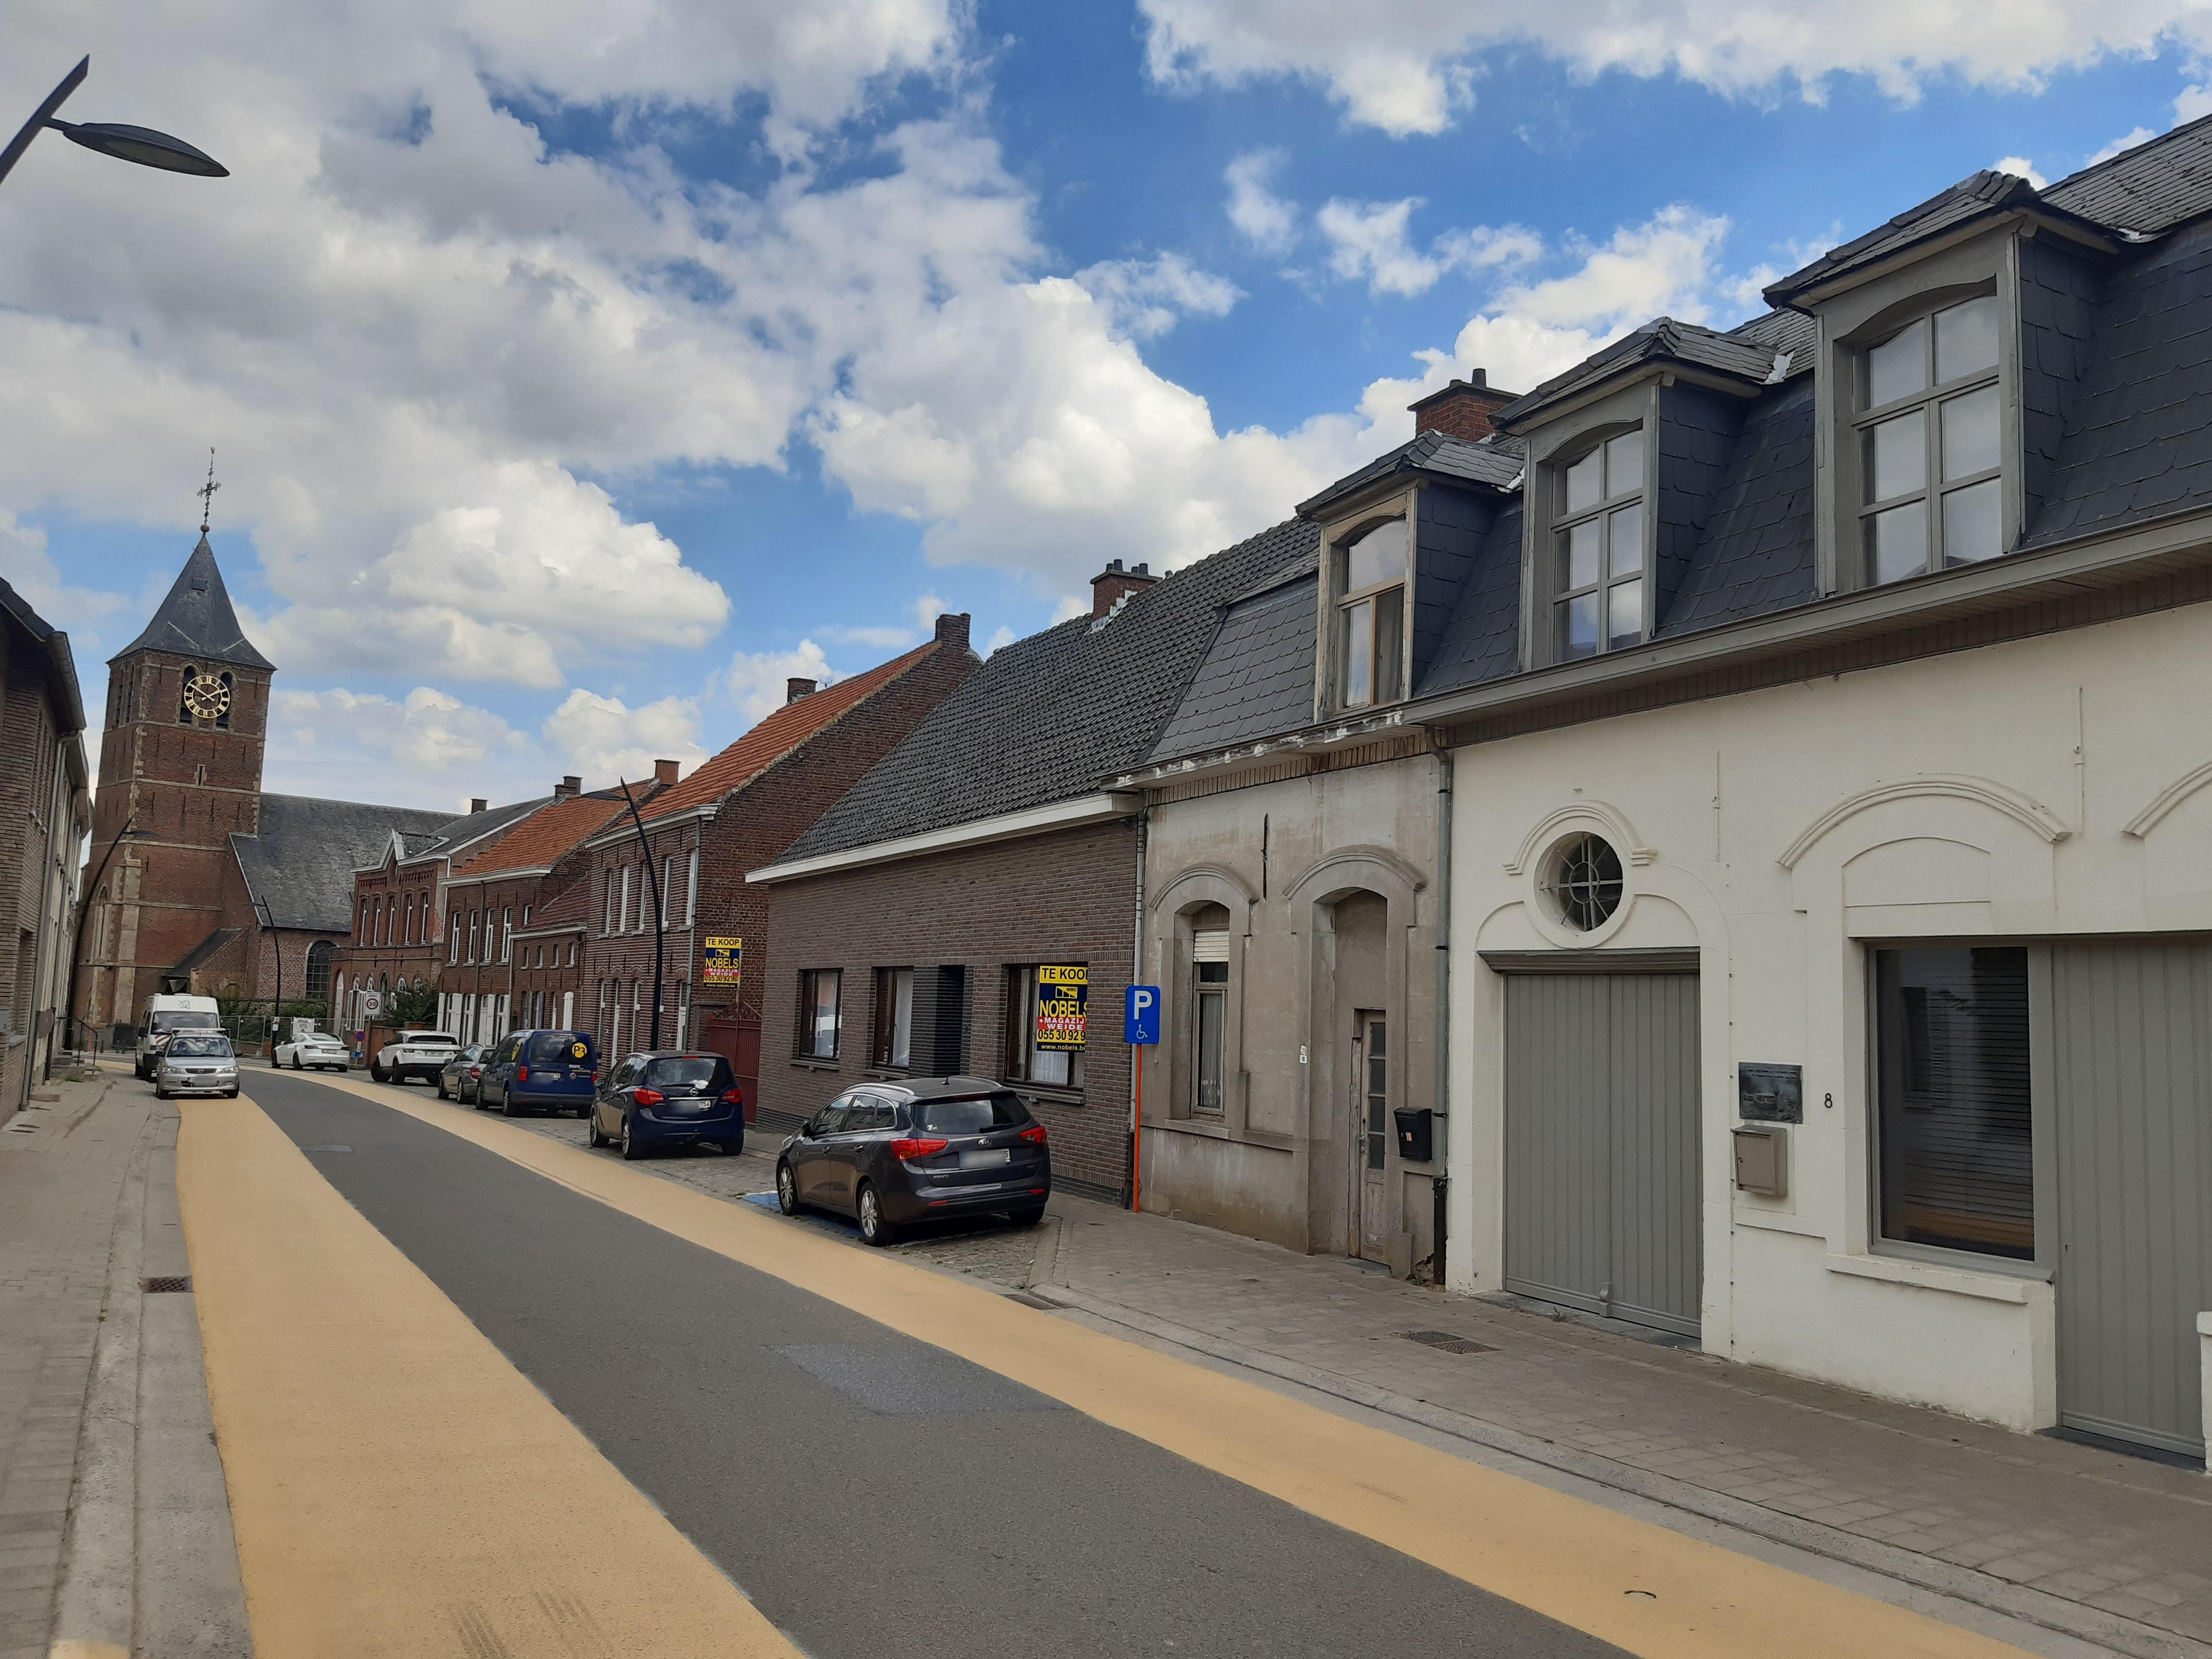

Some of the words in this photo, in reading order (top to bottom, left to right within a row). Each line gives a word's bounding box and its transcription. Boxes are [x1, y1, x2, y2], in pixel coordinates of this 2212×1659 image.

[705, 957, 738, 969] NOBELS
[1042, 968, 1056, 979] TE
[1134, 990, 1152, 1020] P
[1038, 1029, 1054, 1040] 055
[1056, 1030, 1066, 1040] 30
[1068, 1031, 1079, 1041] 92
[1081, 1031, 1086, 1041] 9
[1824, 1093, 1833, 1108] 8
